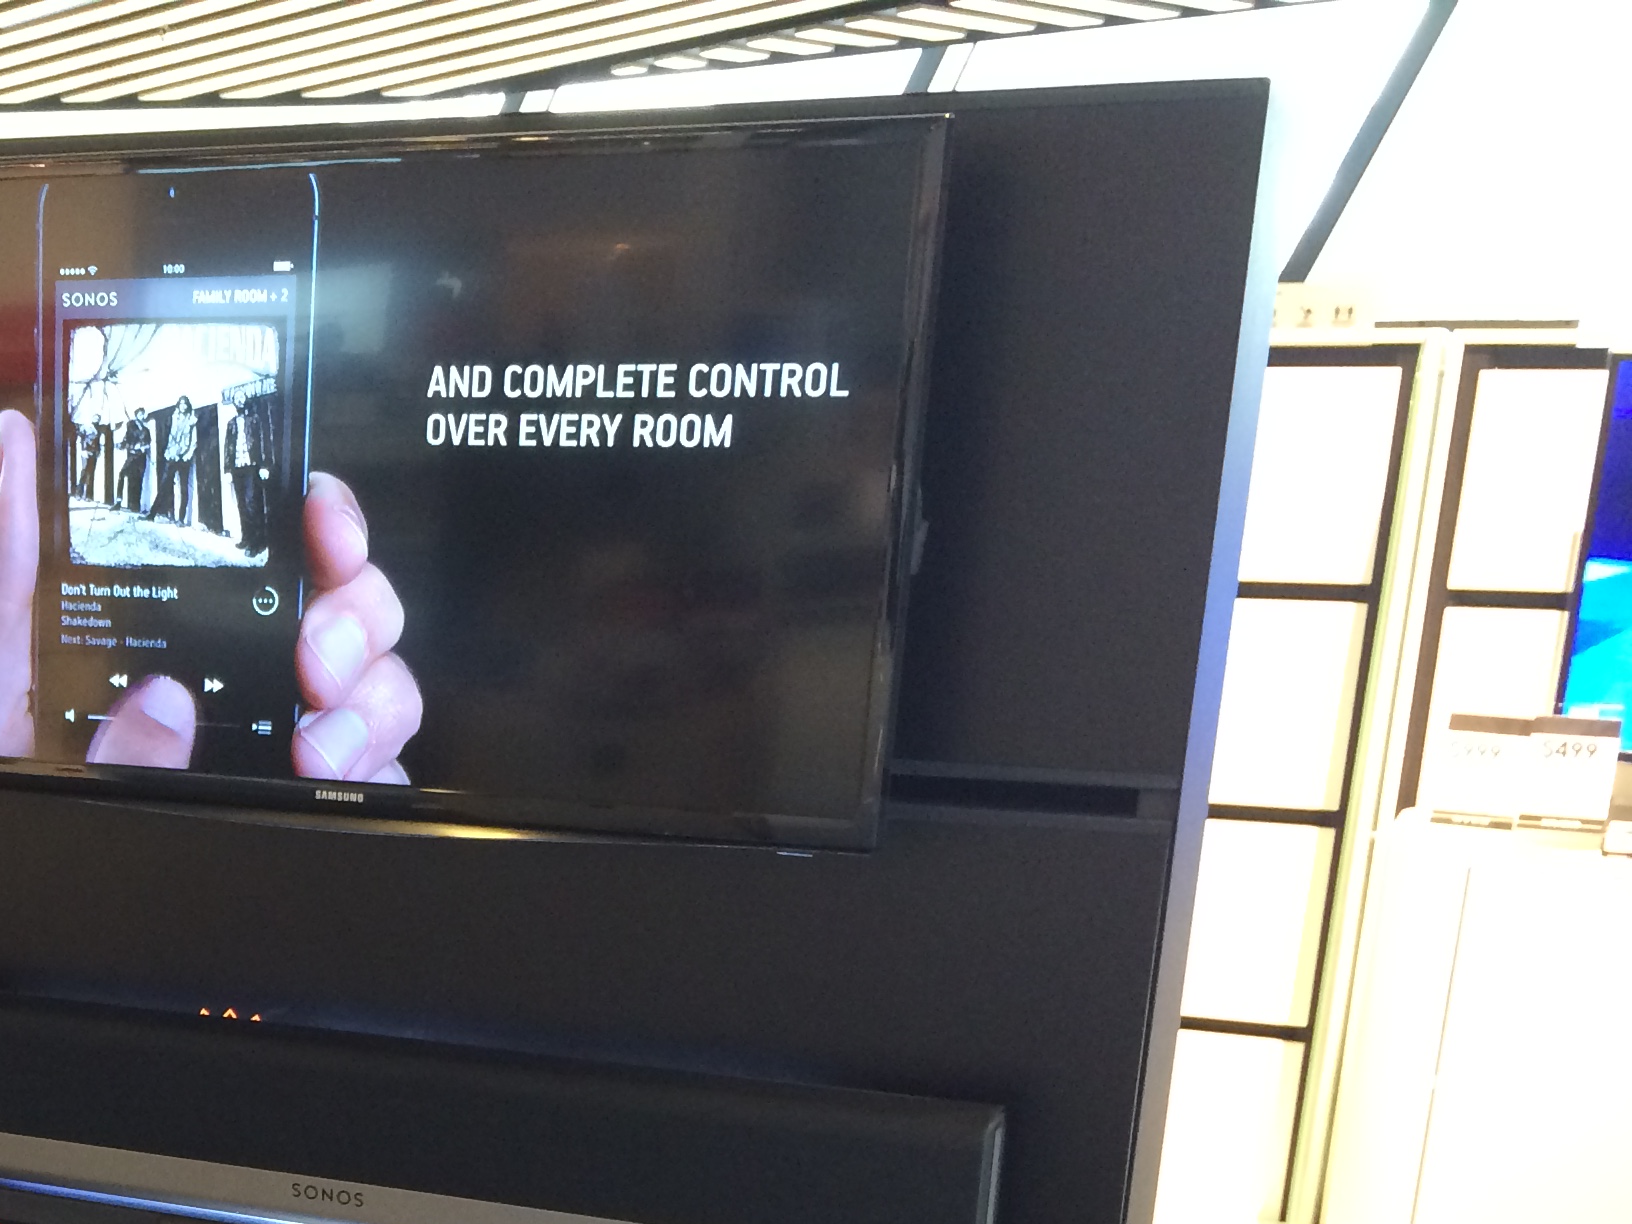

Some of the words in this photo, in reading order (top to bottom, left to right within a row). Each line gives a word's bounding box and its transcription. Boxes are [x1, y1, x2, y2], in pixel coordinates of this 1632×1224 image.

[61, 291, 119, 308] SONOS
[192, 289, 232, 305] FAMILY
[233, 288, 268, 304] ROOM
[280, 288, 290, 303] 2
[426, 365, 493, 399] AND
[503, 364, 678, 399] COMPLETE
[688, 362, 850, 399] CONTROL
[426, 413, 508, 447] OVER
[518, 413, 623, 448] EVERY
[632, 413, 734, 449] ROOM
[60, 582, 87, 597] Don't
[88, 583, 111, 598] Turn
[112, 584, 131, 599] Out
[132, 585, 150, 599] the
[151, 586, 179, 602] Light
[60, 600, 102, 613] Hacienda
[60, 616, 112, 629] Shakedown
[85, 635, 118, 649] Savage
[125, 636, 167, 650] Hacienda
[314, 789, 365, 804] SAMSUNG
[291, 1181, 365, 1208] SONOS
